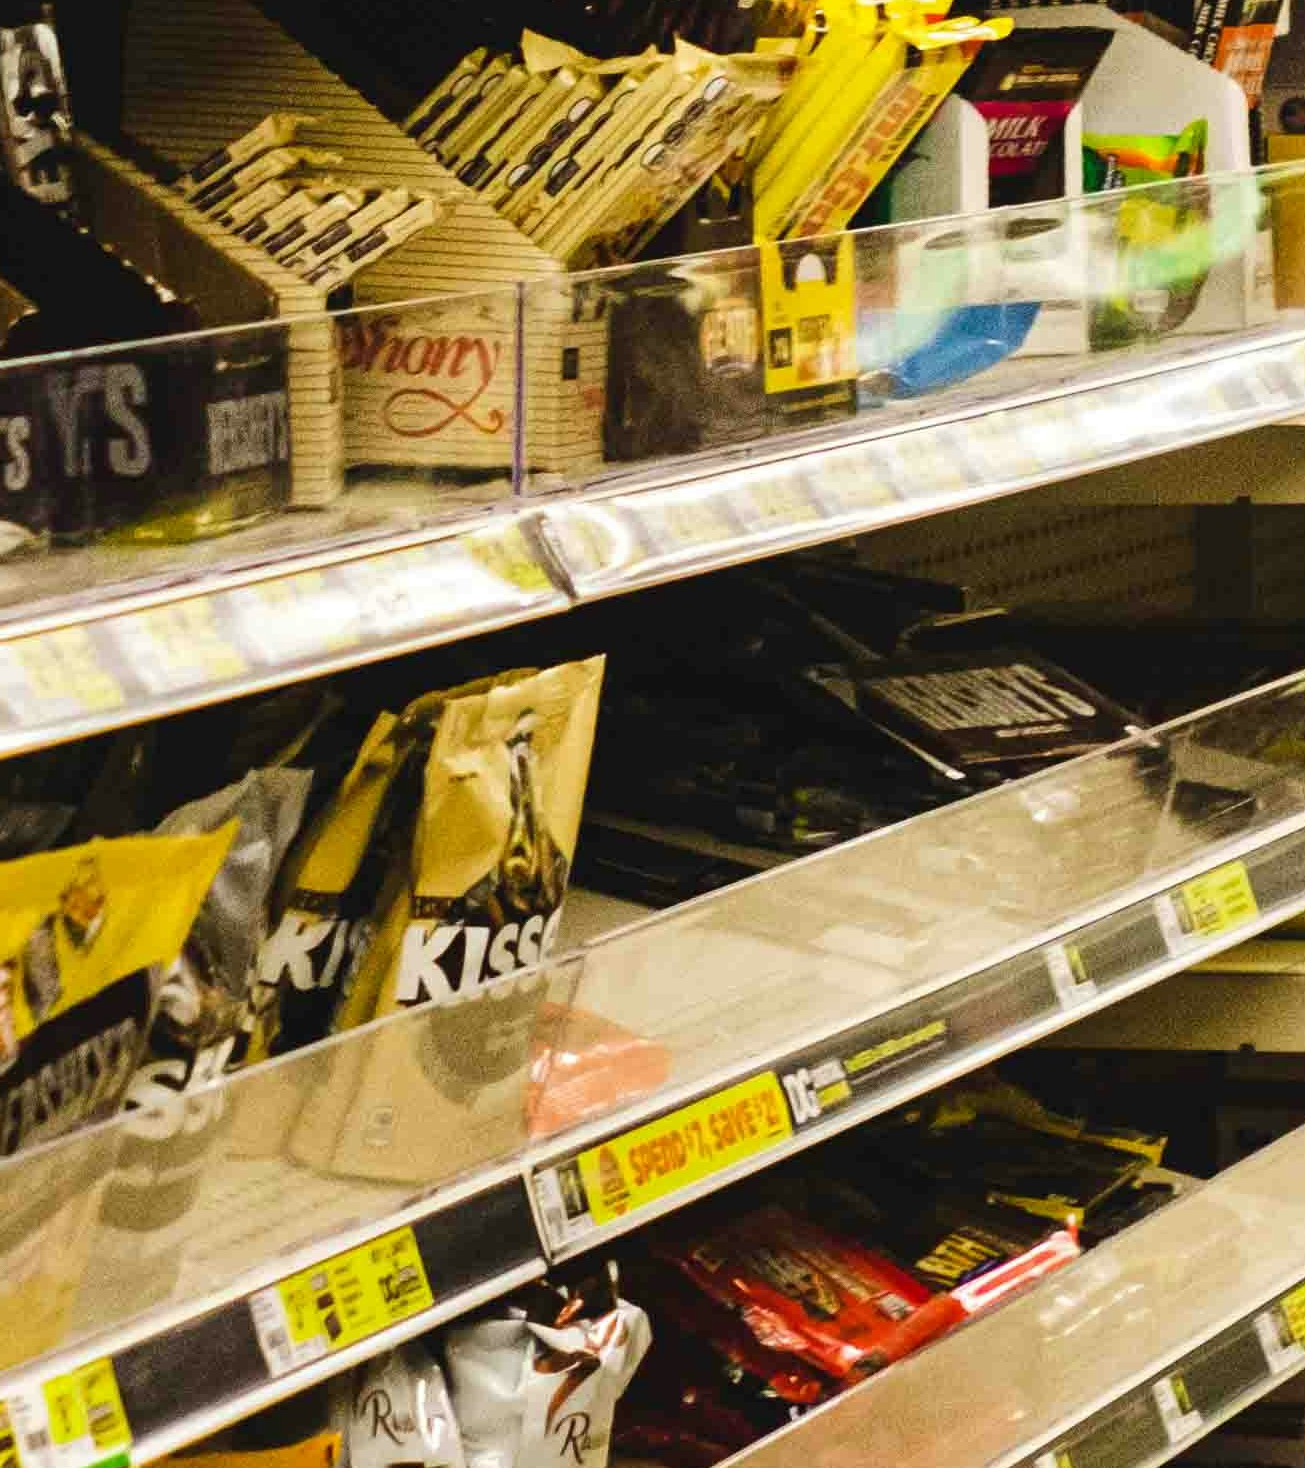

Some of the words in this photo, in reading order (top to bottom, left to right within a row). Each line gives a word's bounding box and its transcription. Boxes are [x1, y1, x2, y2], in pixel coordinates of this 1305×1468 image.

[988, 114, 1049, 141] MILK
[397, 908, 562, 1006] KISS
[627, 1131, 688, 1188] SPEND
[708, 1100, 759, 1152] SAVE
